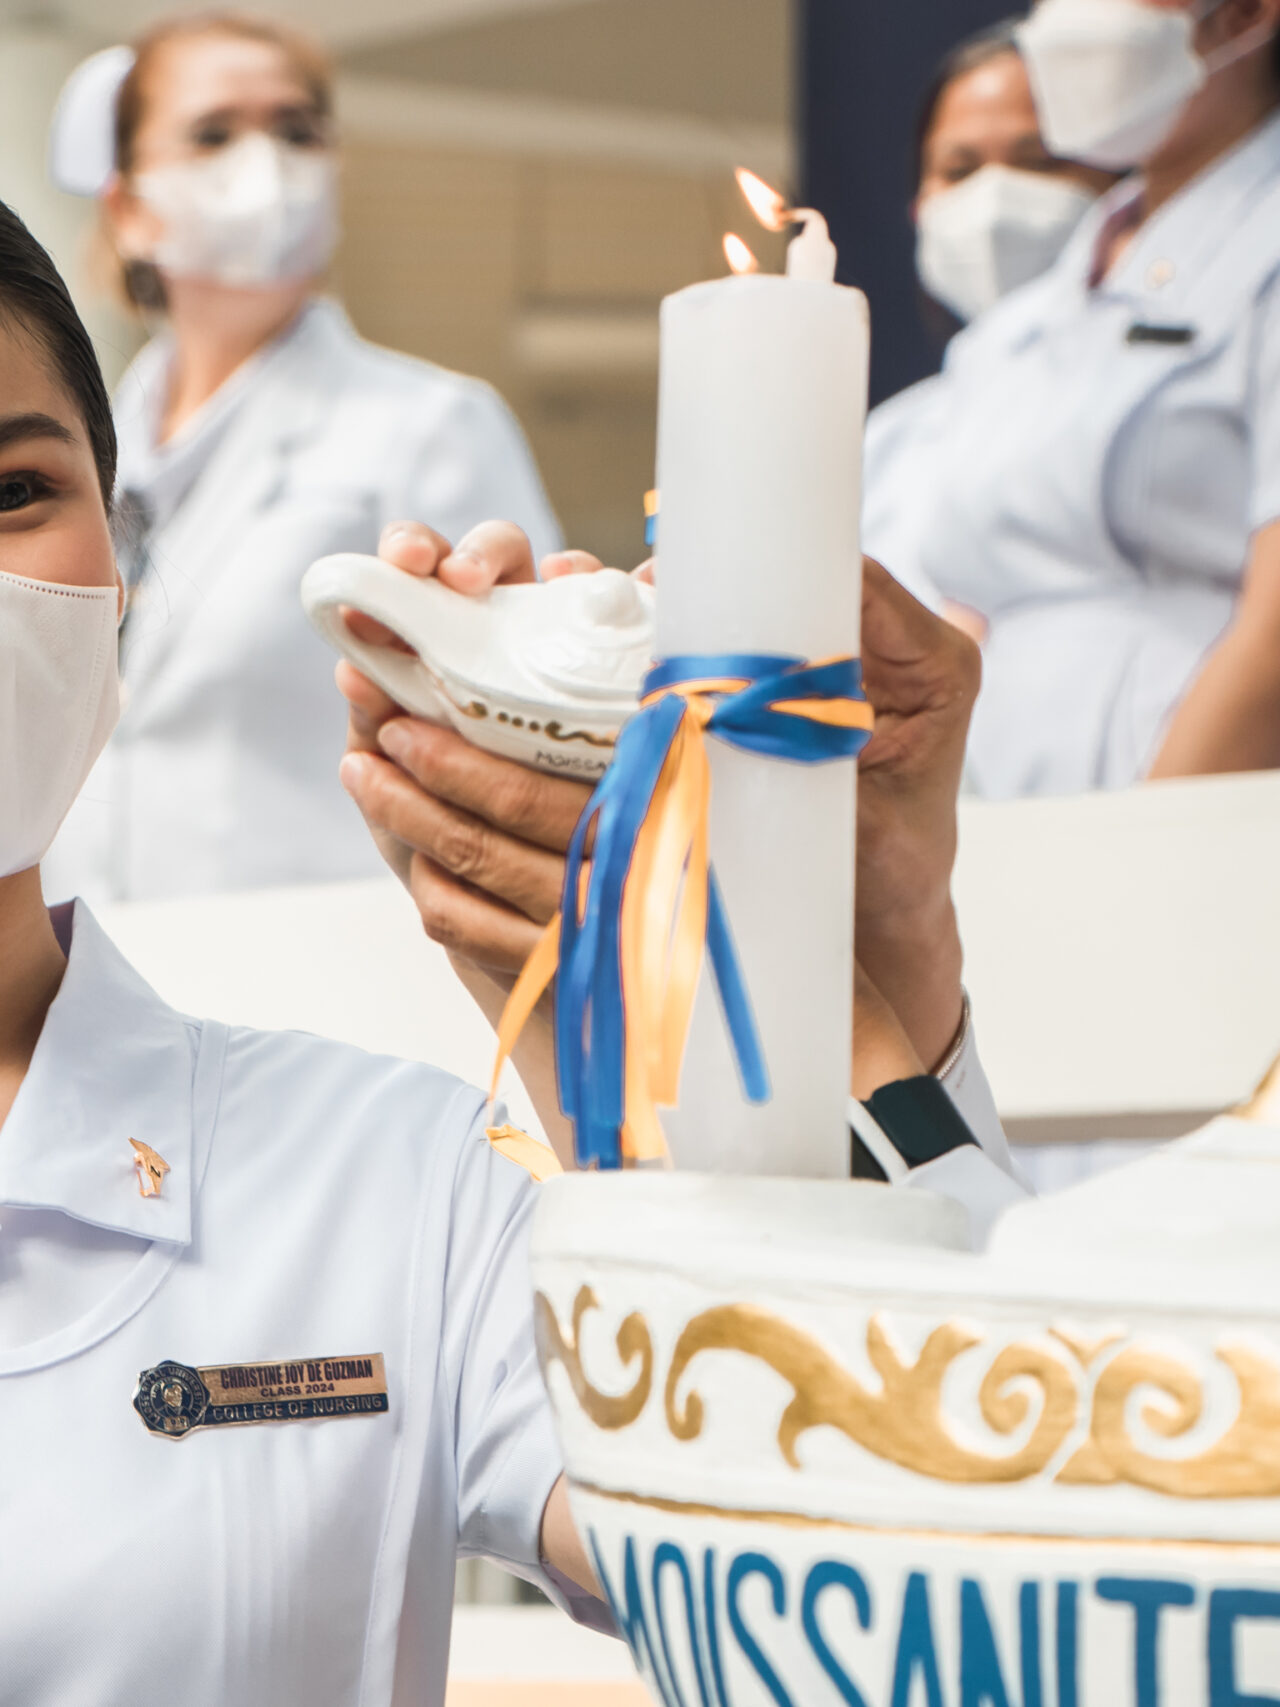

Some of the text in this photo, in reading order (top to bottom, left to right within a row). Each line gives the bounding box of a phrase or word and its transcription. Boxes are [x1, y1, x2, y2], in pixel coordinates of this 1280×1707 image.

[535, 750, 608, 771] MOISSA
[221, 1359, 373, 1389] CHRISTINE JOY DE GUZMAN
[261, 1383, 335, 1397] CLASS 2024
[213, 1396, 382, 1420] COLLEGE OF NURSING
